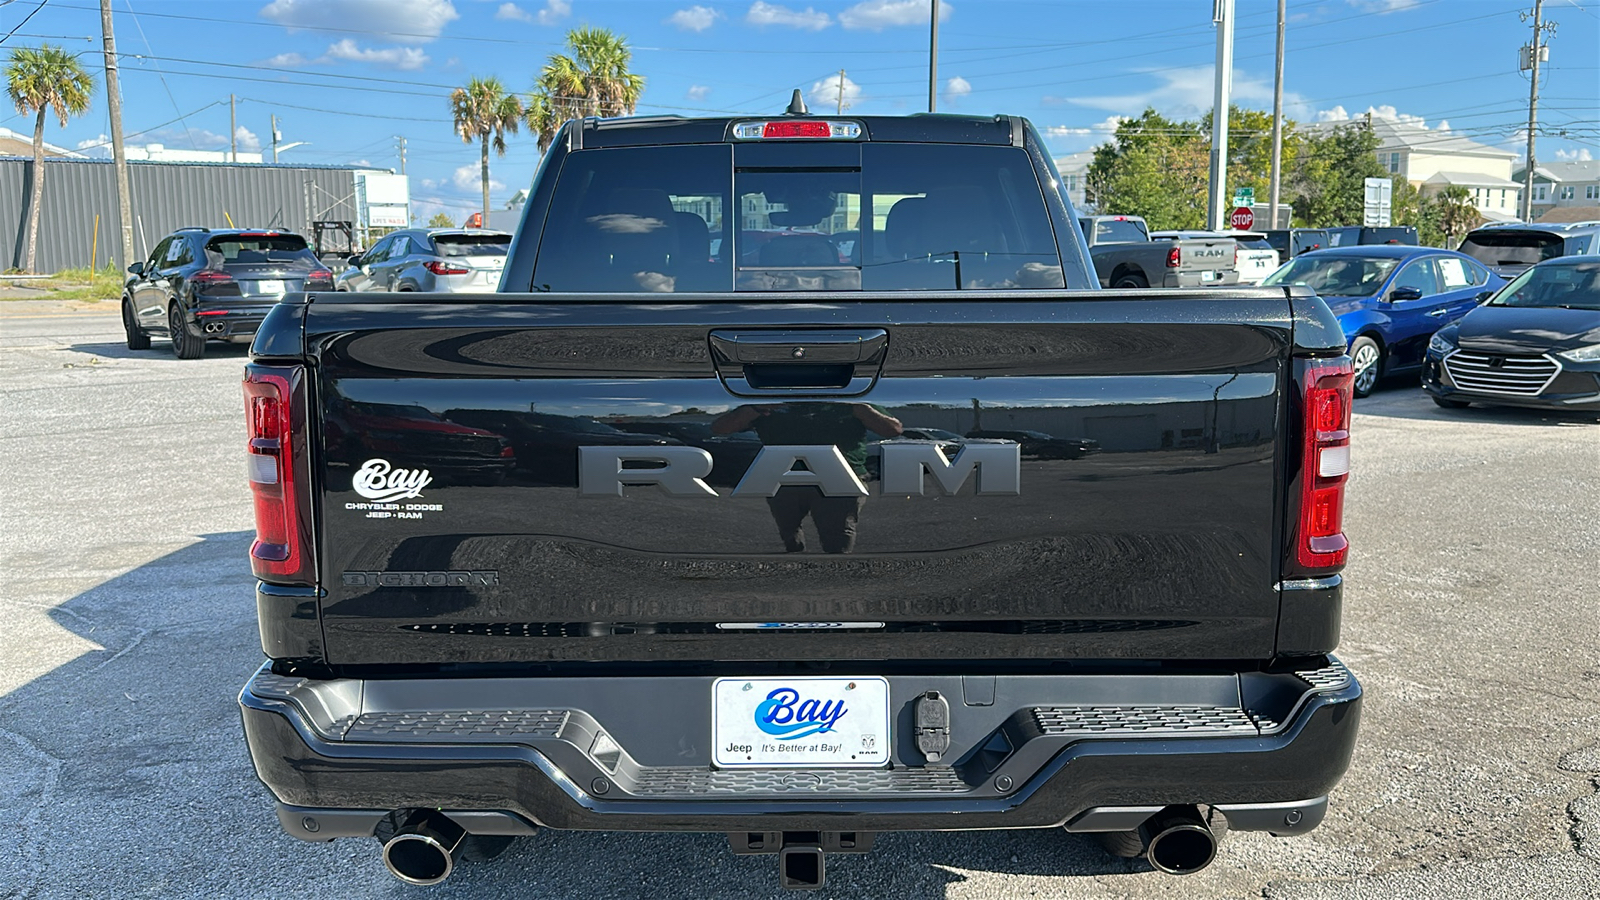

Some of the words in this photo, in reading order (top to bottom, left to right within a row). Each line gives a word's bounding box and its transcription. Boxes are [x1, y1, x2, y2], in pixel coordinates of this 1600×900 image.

[1232, 214, 1253, 225] STOP
[578, 443, 1022, 497] RAM
[355, 458, 433, 499] Bay
[345, 502, 400, 511] CHRYSLER
[365, 511, 392, 519] JEEP
[342, 570, 499, 587] BIGHORN
[762, 687, 849, 734] Bay
[725, 742, 753, 754] Jeep
[761, 743, 776, 753] It's
[778, 743, 807, 753] Better
[809, 744, 818, 753] at
[820, 743, 842, 754] Bay!
